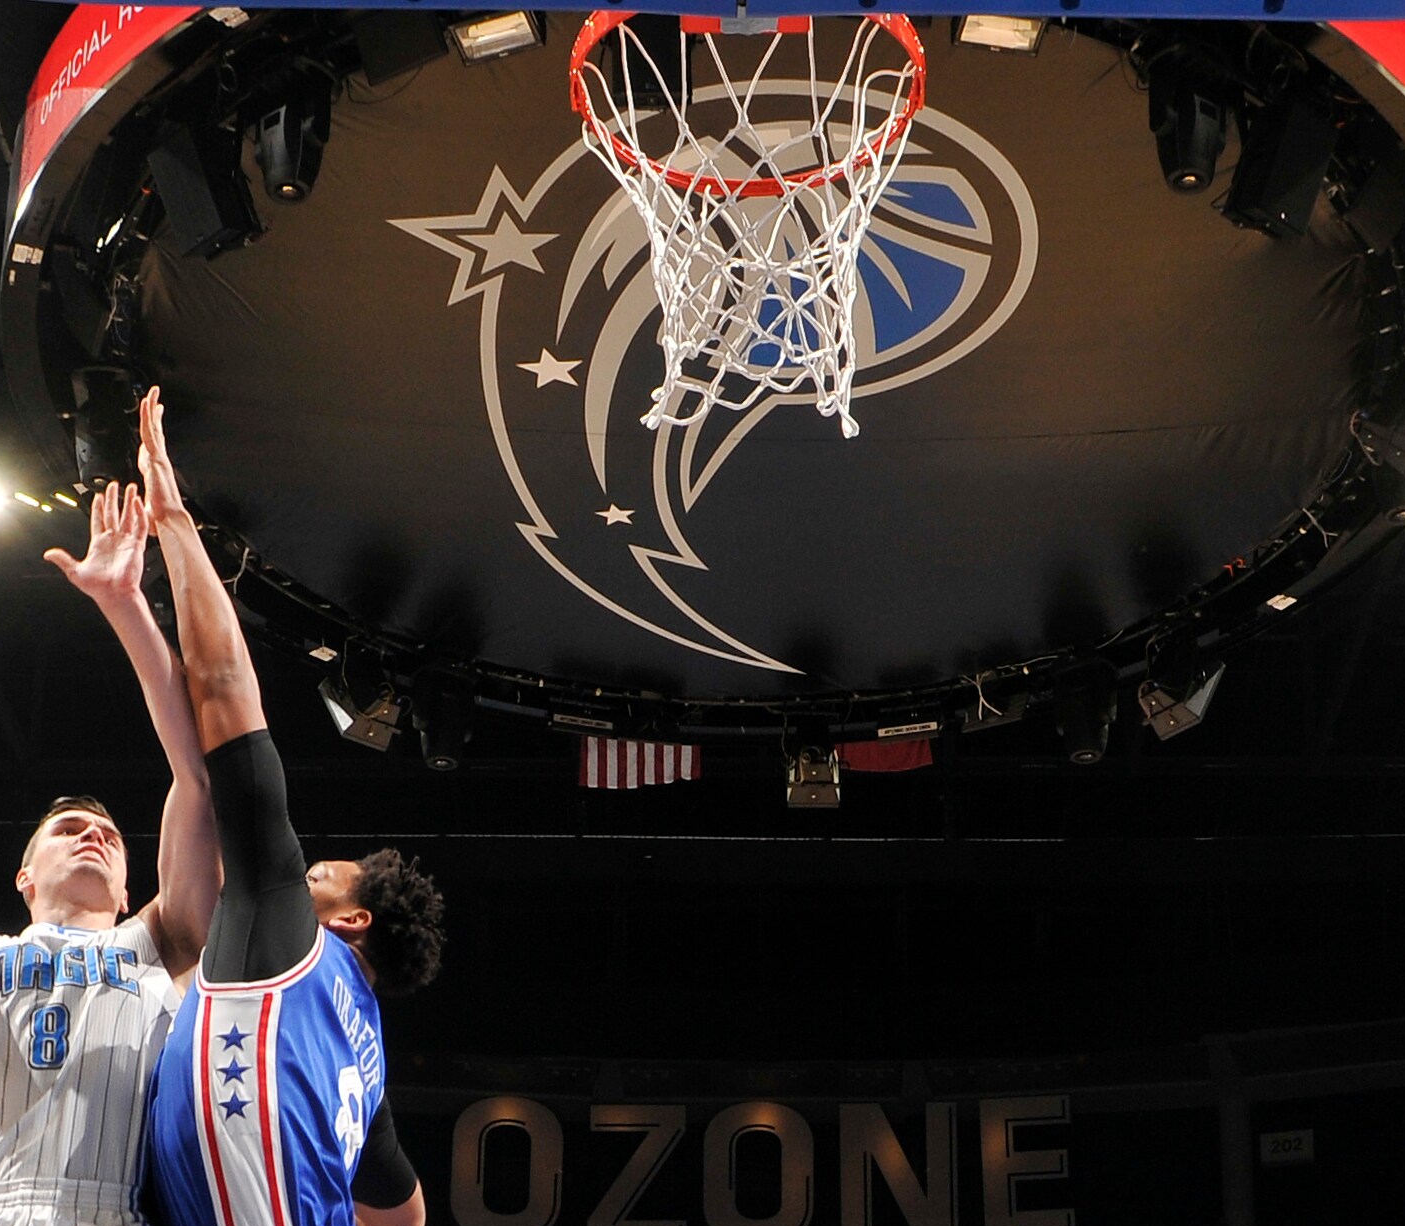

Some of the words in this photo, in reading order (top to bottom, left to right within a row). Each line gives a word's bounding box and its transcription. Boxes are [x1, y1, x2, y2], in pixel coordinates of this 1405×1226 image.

[40, 20, 112, 125] OFFICIAL
[28, 1003, 70, 1070] 8
[333, 975, 381, 1092] OKAFOR
[1271, 1138, 1303, 1154] 202
